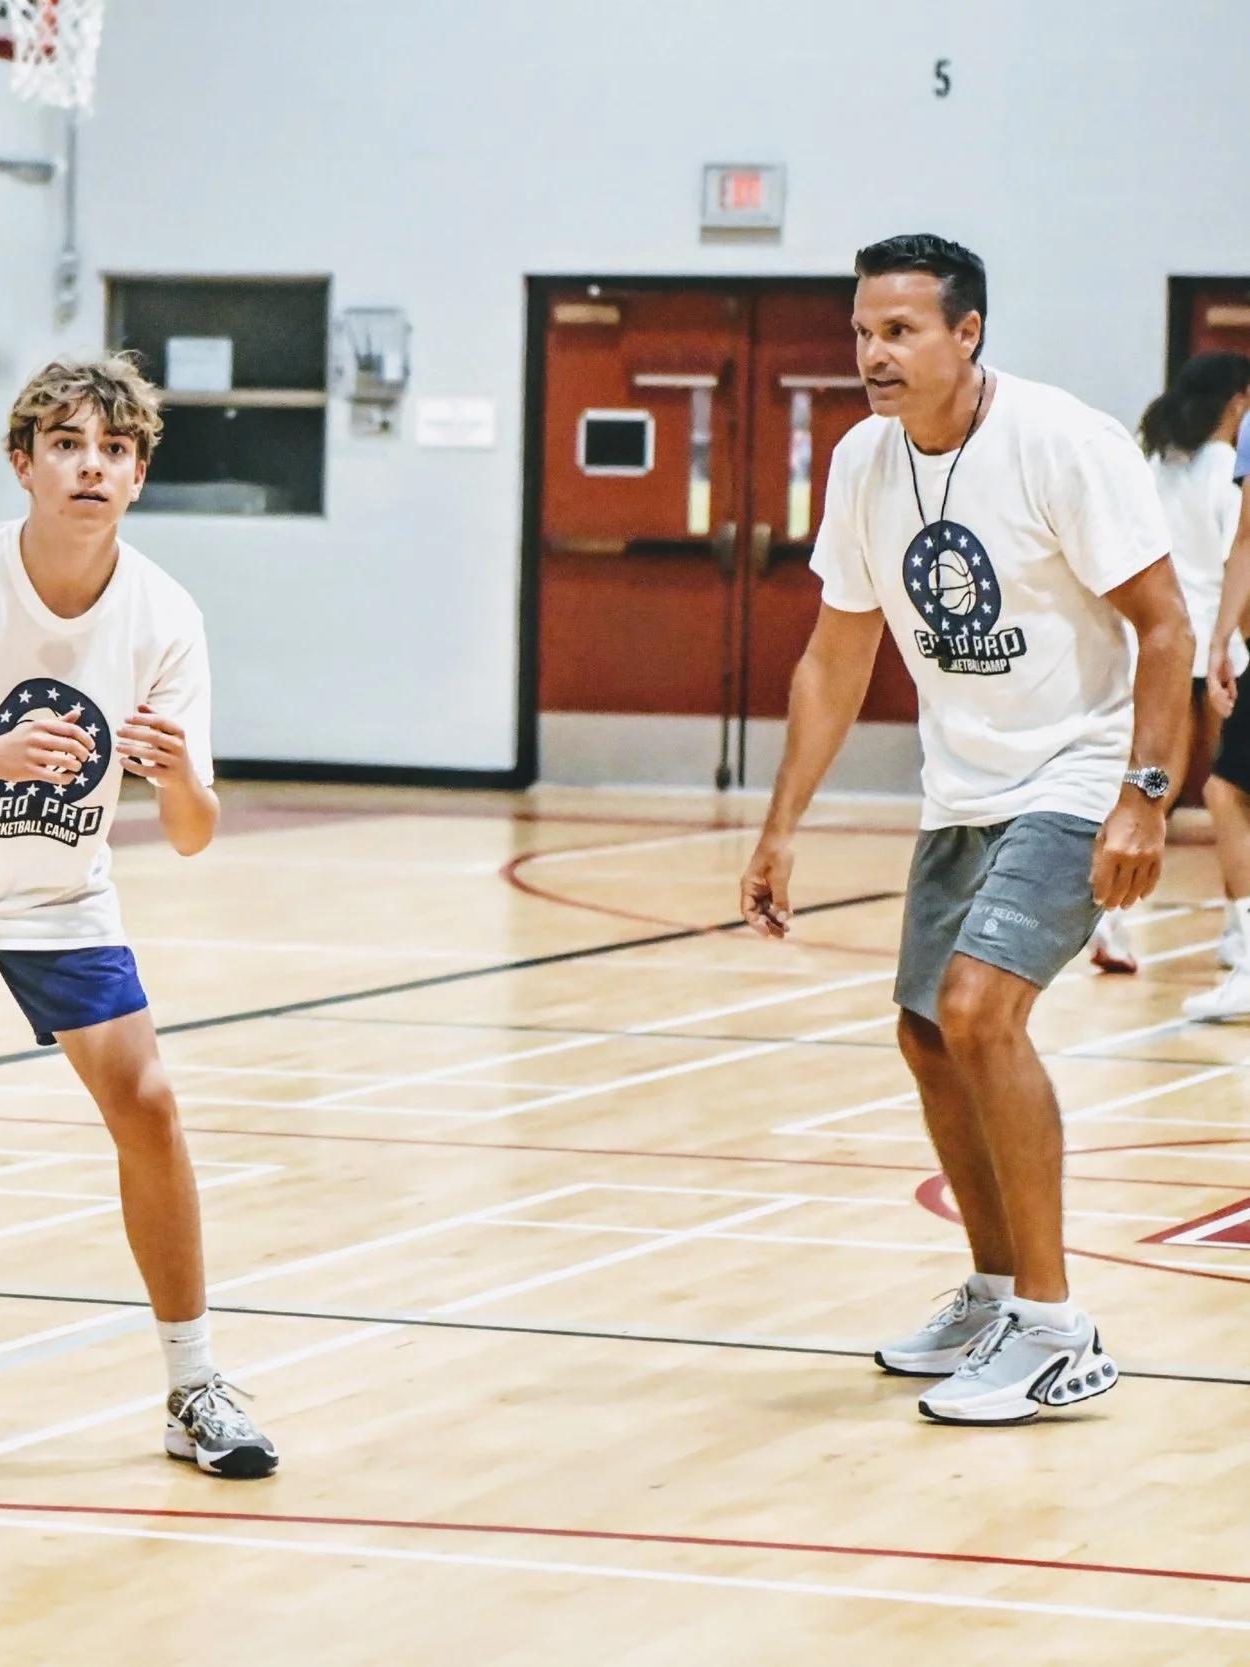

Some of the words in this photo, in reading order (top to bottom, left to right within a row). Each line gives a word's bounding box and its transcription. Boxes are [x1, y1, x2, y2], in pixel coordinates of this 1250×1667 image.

[934, 58, 951, 97] 5
[972, 629, 1021, 657] PRO
[944, 658, 980, 673] KETBALL
[980, 658, 1007, 673] CAMP
[41, 796, 100, 833] PRO
[44, 821, 77, 843] CAMP
[991, 906, 1040, 929] SECOND
